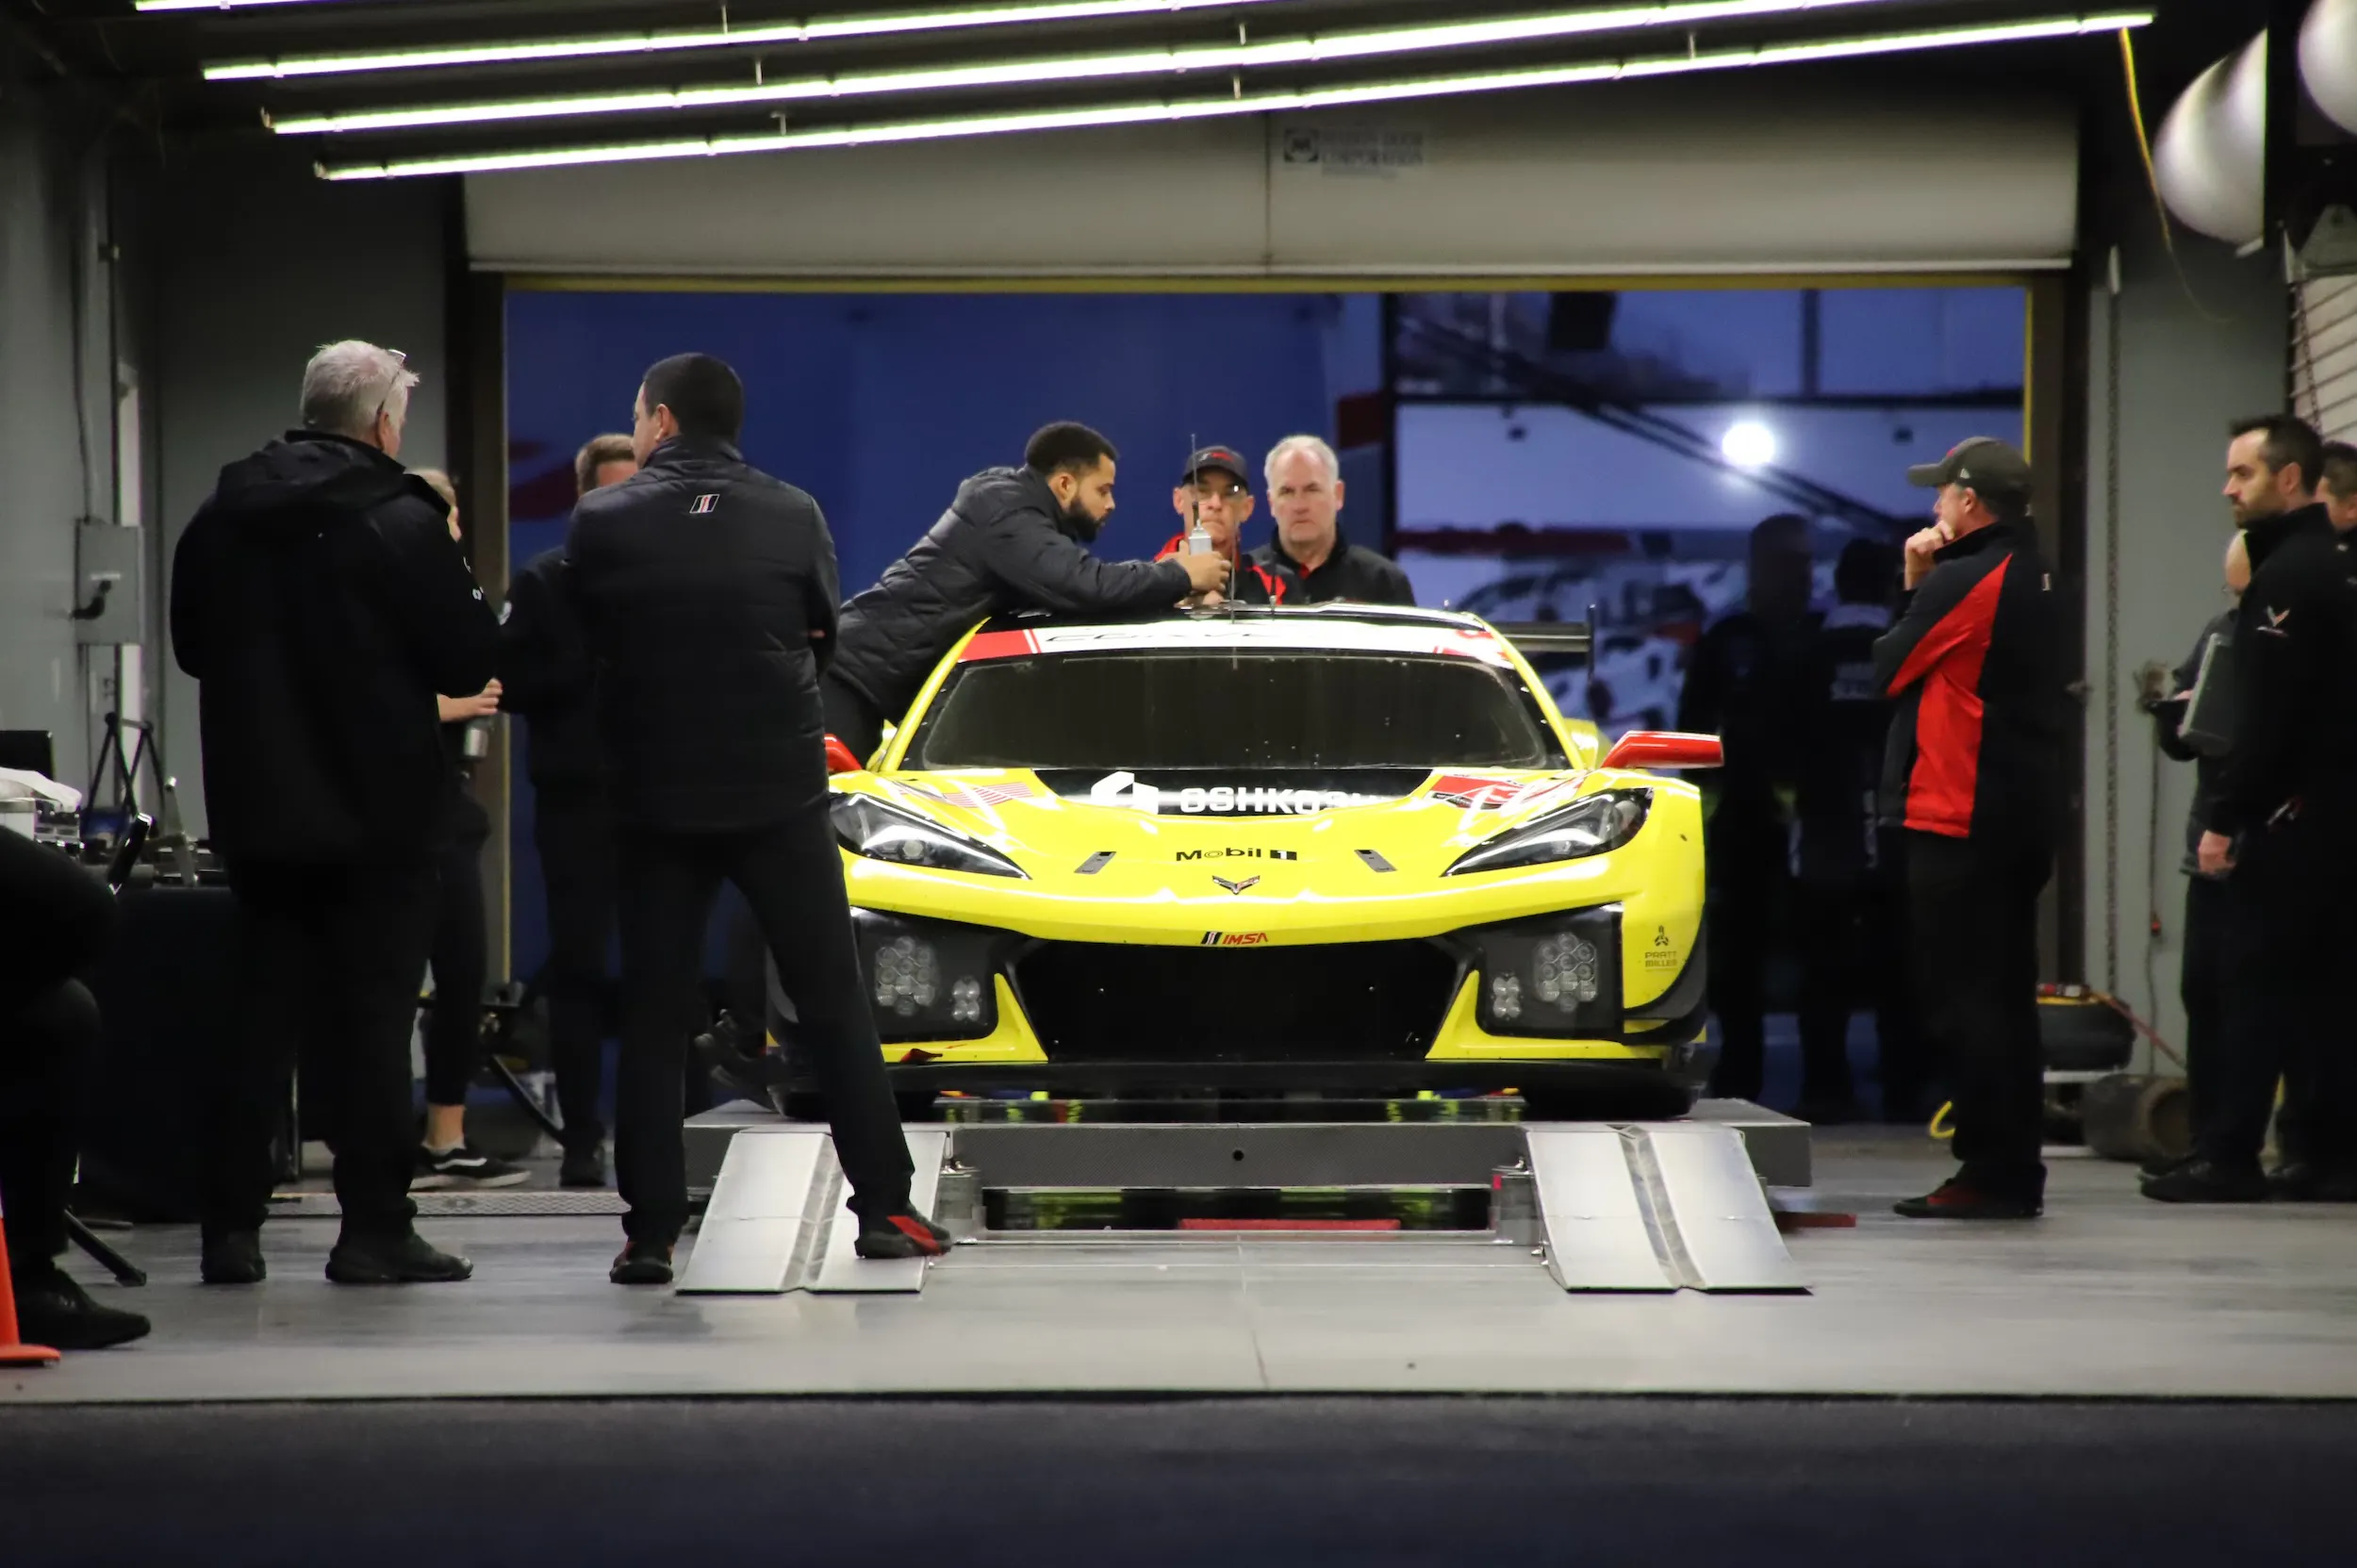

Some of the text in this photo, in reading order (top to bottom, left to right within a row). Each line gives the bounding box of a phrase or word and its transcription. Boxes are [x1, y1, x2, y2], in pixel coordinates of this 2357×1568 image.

[1176, 847, 1261, 861] Mobil
[1222, 932, 1269, 945] IMSA
[1644, 950, 1677, 959] PRATT
